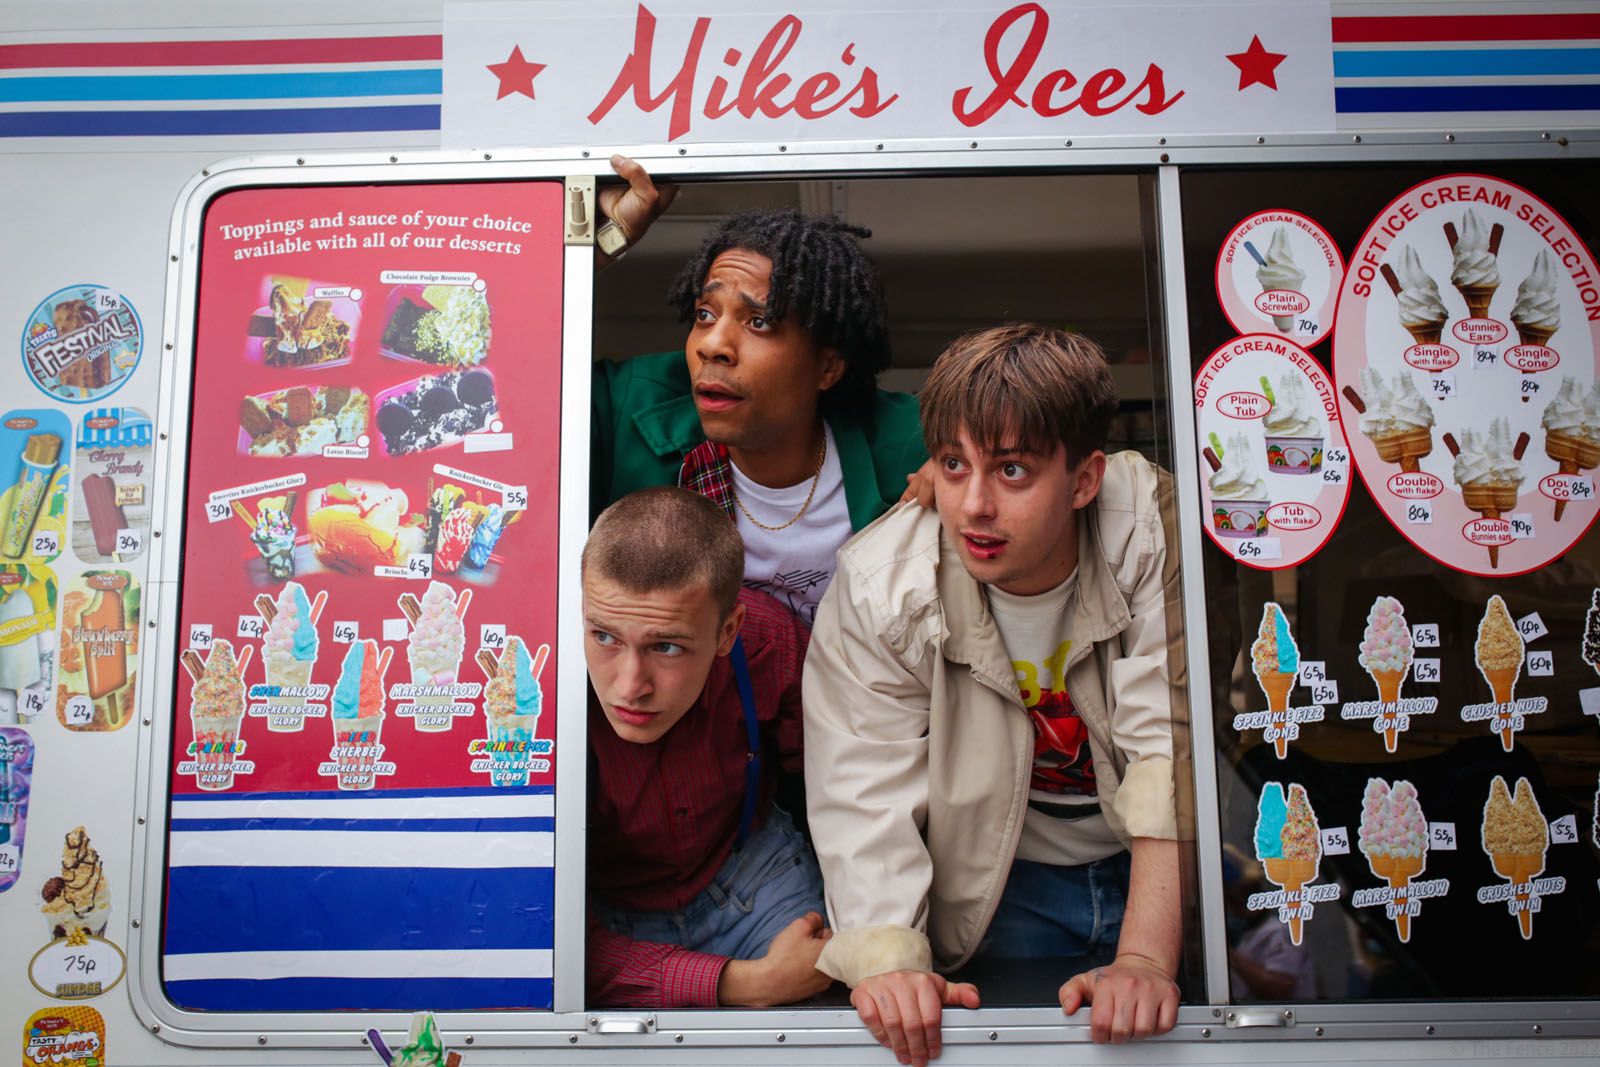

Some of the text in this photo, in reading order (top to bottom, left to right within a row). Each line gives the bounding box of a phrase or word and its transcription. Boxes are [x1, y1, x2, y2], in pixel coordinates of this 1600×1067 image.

[587, 2, 1185, 142] Mike's Ices
[220, 210, 532, 242] Toppings and sauce of your choice
[234, 232, 522, 261] available with all of our desserts
[1226, 215, 1335, 267] SOFT ICE CREAM SELECTION
[1353, 185, 1600, 321] SOFT ICE CREAM SELECTION
[386, 273, 471, 282] Chocolate Fudge Brownies
[321, 288, 345, 297] Waffles
[1268, 293, 1296, 302] Plain
[100, 296, 118, 308] 15p
[1262, 302, 1303, 311] Screwball
[1299, 319, 1318, 335] 70p
[1461, 323, 1501, 332] Bunnies
[1469, 333, 1493, 341] Ears
[36, 314, 132, 378] FESTIVAL
[1414, 347, 1450, 358] Single
[1477, 351, 1496, 364] 80p
[1514, 348, 1550, 359] Single
[1412, 358, 1452, 366] with flake
[1517, 359, 1549, 368] Cone
[1194, 341, 1338, 423] SOFT ICE CREAM SELECTION
[1433, 380, 1451, 394] 75p
[1521, 380, 1540, 393] 80p
[1231, 395, 1258, 405] Plain
[1235, 407, 1256, 416] Tub
[326, 448, 368, 457] Lotus Biscoff
[1327, 451, 1346, 462] 65p
[449, 469, 493, 488] Knickerbocker
[1323, 470, 1341, 482] 65p
[1395, 477, 1437, 487] Double
[1396, 487, 1436, 495] with flake
[1572, 482, 1590, 498] 85p
[507, 492, 526, 507] 55p
[210, 504, 231, 518] 30p
[1283, 506, 1304, 516] Tub
[1408, 506, 1429, 521] 80p
[1273, 517, 1314, 525] with flake
[1474, 522, 1509, 532] Double
[1511, 519, 1532, 535] 90p
[120, 537, 139, 549] 30p
[1471, 533, 1497, 541] Bunnies
[35, 538, 57, 552] 25p
[1239, 542, 1261, 556] 65p
[409, 559, 430, 577] 45p
[240, 621, 263, 637] 42p
[335, 626, 356, 641] 45p
[1521, 621, 1540, 635] 60p
[191, 631, 211, 643] 45p
[484, 629, 503, 645] 40p
[1416, 629, 1436, 643] 65p
[1530, 657, 1552, 670] 60p
[1304, 668, 1324, 681] 65p
[1416, 664, 1437, 680] 65p
[391, 685, 480, 697] MARSHMALLOW
[1314, 688, 1334, 701] 65p
[26, 693, 43, 712] 18p
[1342, 699, 1437, 718] MARSHMALLOW
[1462, 699, 1547, 719] CRUSHED NUTS
[73, 705, 91, 721] 22p
[250, 705, 325, 715] KNICKER BOCKER
[397, 704, 473, 715] KNICKER BOCKER
[273, 717, 300, 726] GLORY
[421, 716, 448, 726] GLORY
[1235, 707, 1324, 729] SPRINKLE FIZZ
[1374, 717, 1408, 732] CONE
[1491, 716, 1524, 731] CONE
[337, 731, 376, 743] MIXED
[1264, 727, 1298, 742] CONE
[188, 741, 244, 754] SPRINKLE
[332, 746, 383, 758] SHERBET
[178, 762, 253, 773] KNICKER BOCKER
[320, 763, 394, 774] KNICKER BOCKER
[472, 761, 549, 771] KNICKER BOCKER
[201, 774, 229, 784] GLORY
[342, 775, 370, 785] GLORY
[496, 772, 523, 782] GLORY
[1435, 829, 1454, 845] 55p
[1555, 824, 1575, 841] 55p
[1327, 835, 1347, 848] 55p
[1353, 881, 1449, 905] MARSHMALLOW
[1478, 878, 1565, 901] CRUSHED NUTS
[1249, 885, 1340, 908] SPRINKLE FIZZ
[1387, 902, 1420, 918] TWIN
[1509, 898, 1541, 913] TWIN
[1280, 906, 1312, 920] TWIN
[64, 954, 96, 974] 75p
[31, 1037, 58, 1046] TASTY
